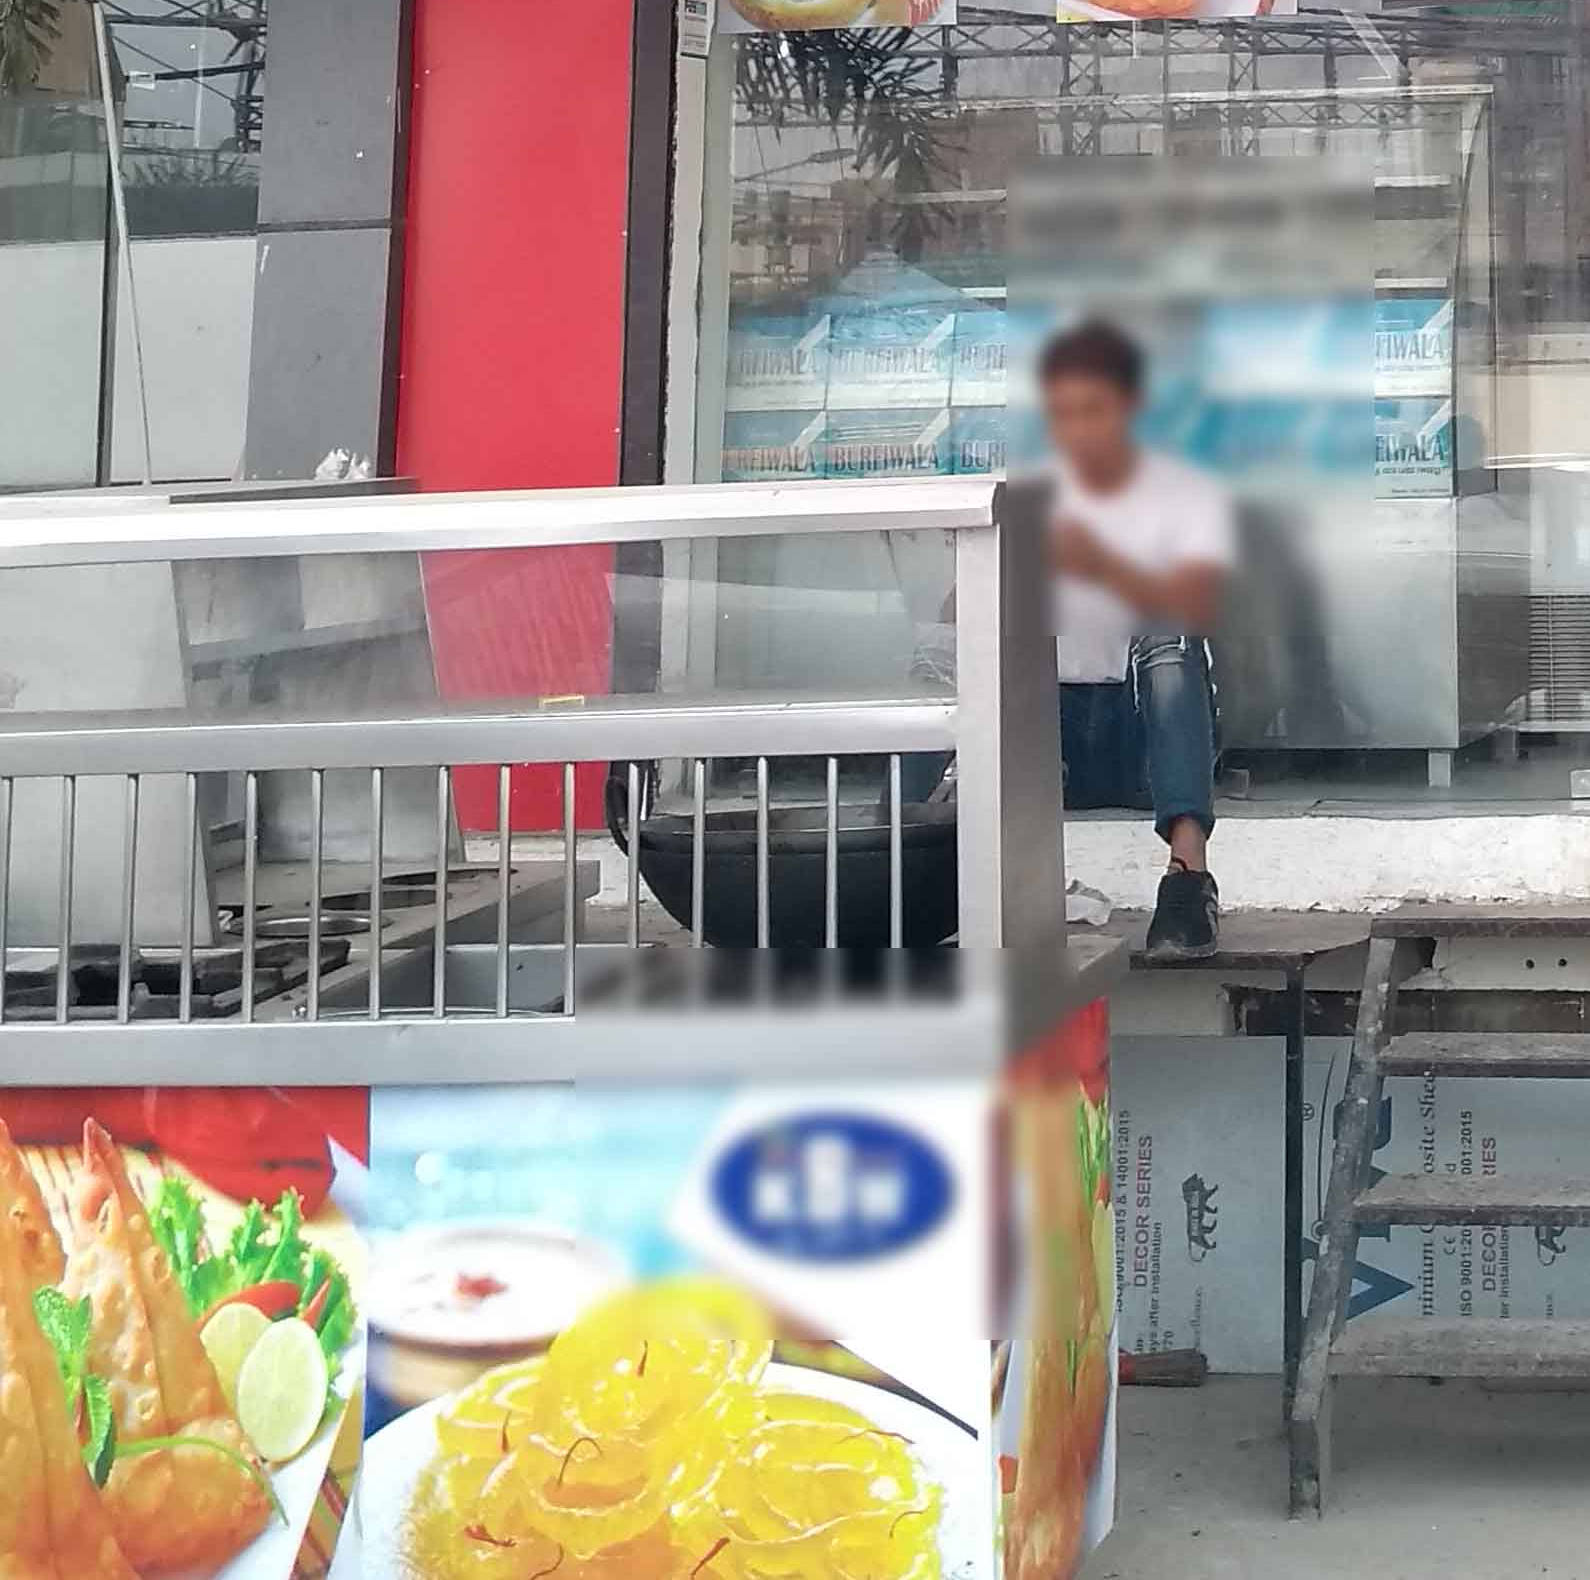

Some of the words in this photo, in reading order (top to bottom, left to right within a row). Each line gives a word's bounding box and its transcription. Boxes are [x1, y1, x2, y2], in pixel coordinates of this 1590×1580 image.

[1135, 1135, 1152, 1208] SERIES
[1133, 1216, 1150, 1287] DECOR
[1460, 1290, 1473, 1317] ISO
